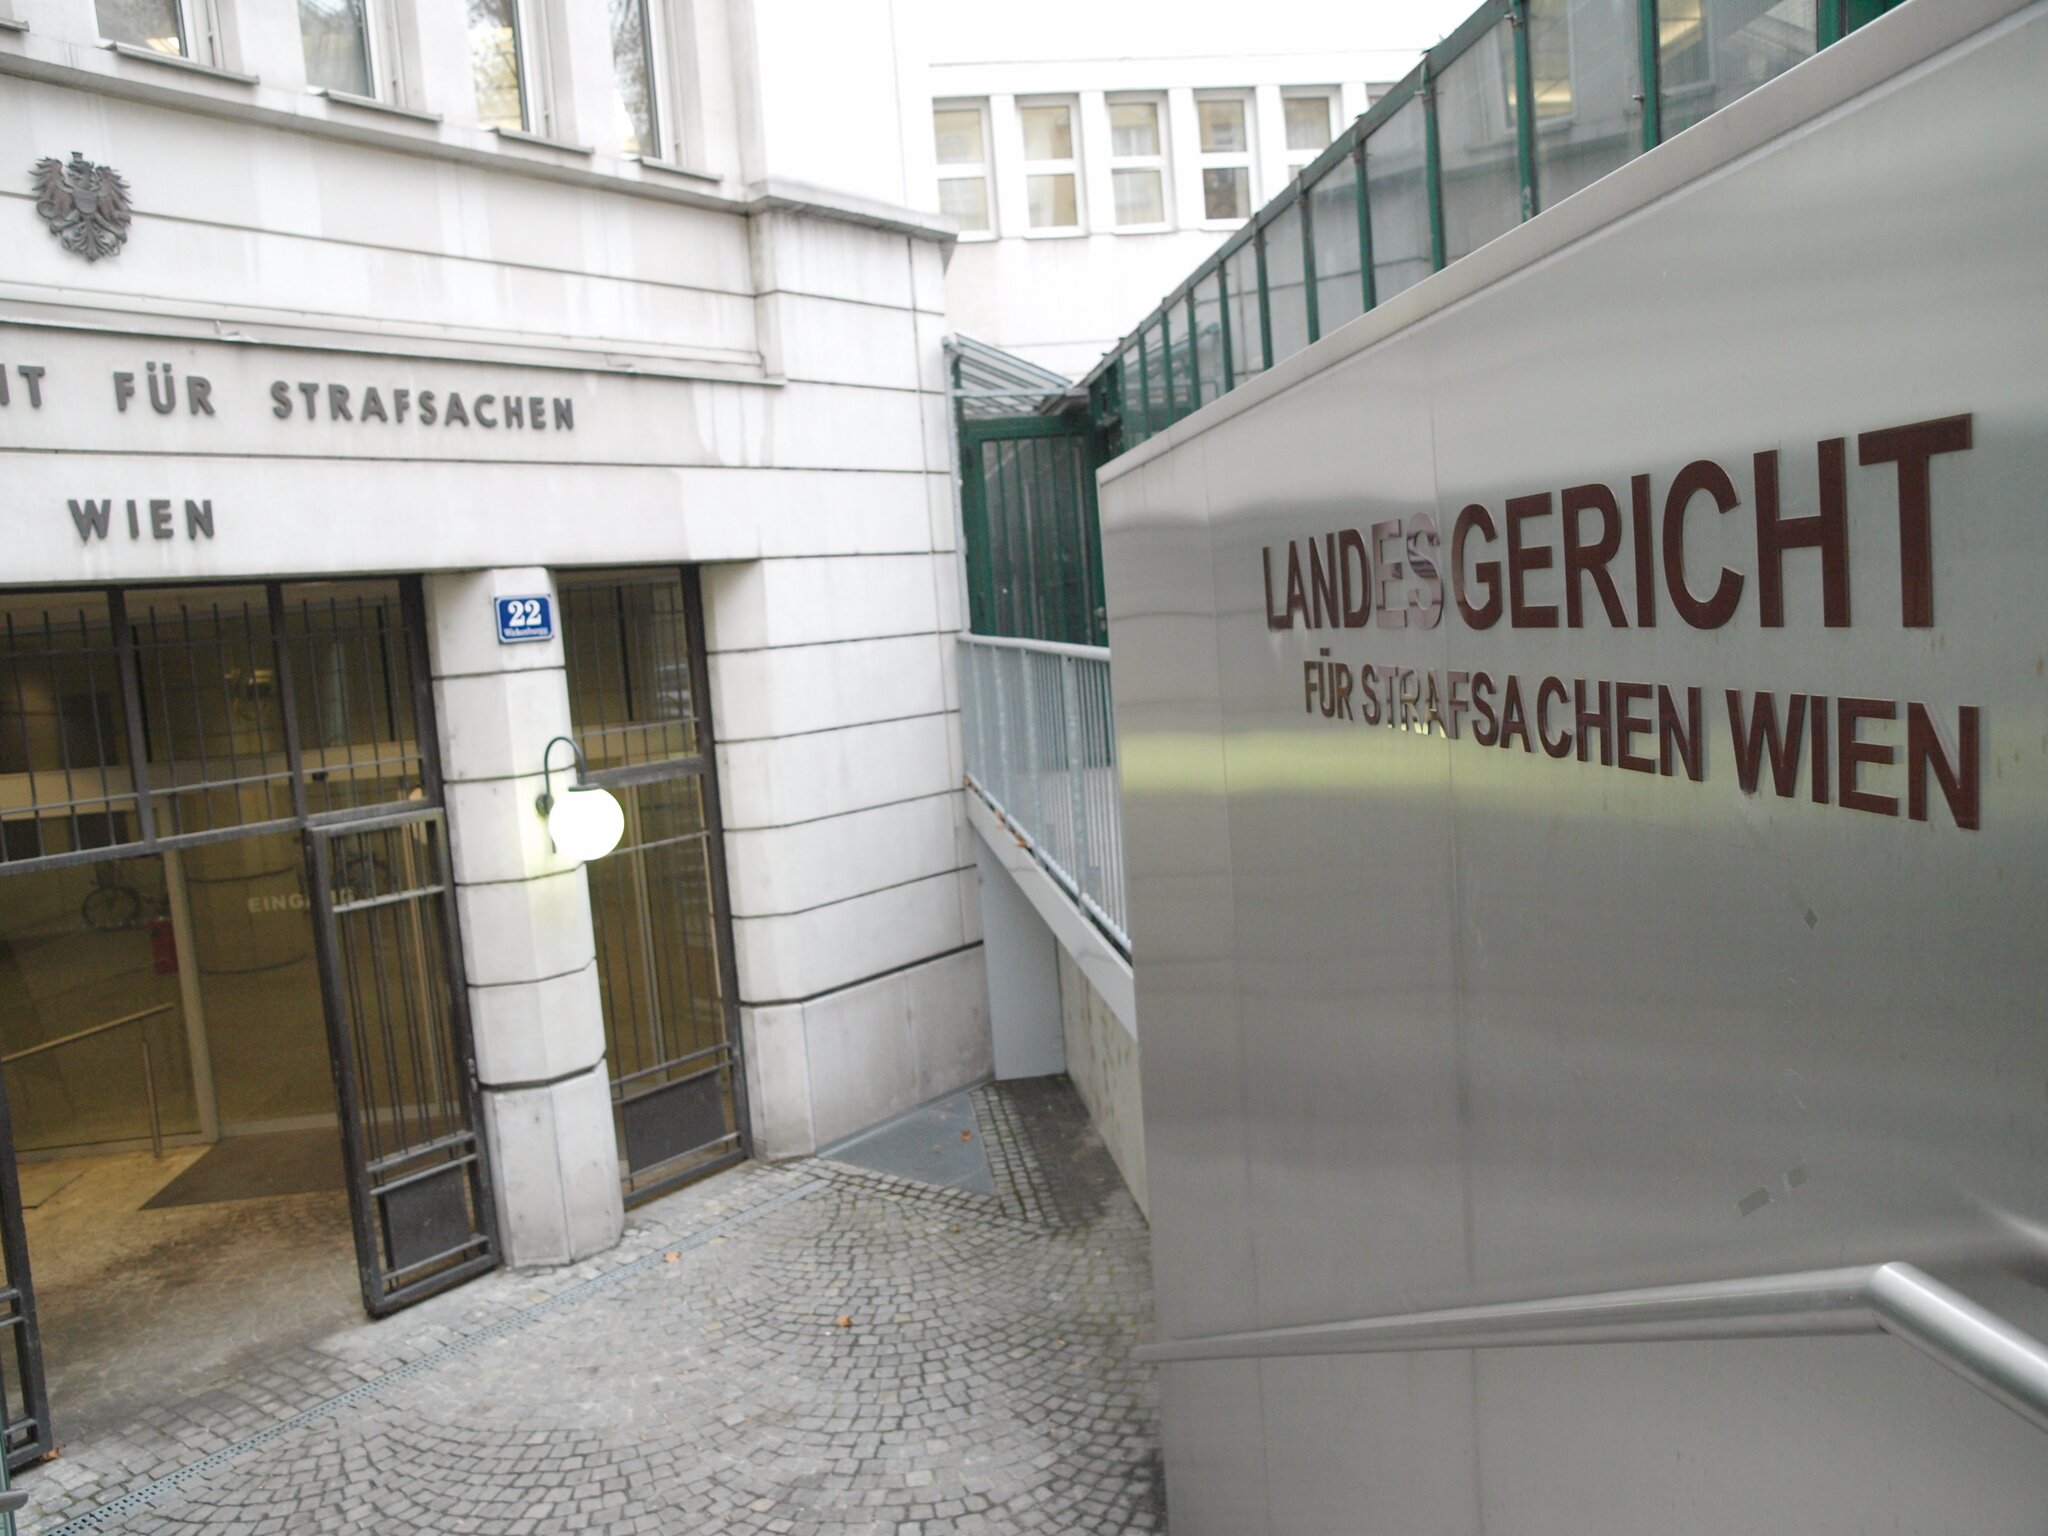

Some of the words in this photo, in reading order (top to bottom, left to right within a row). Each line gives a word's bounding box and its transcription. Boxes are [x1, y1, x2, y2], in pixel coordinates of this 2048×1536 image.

[113, 361, 216, 416] FÜR
[270, 380, 575, 430] STRAFSACHEN
[68, 499, 215, 542] WIEN
[1262, 412, 1973, 631] LANDESGERICHT
[507, 599, 542, 627] 22
[1303, 647, 1354, 722] FÜR
[1361, 663, 1704, 783] STRAFSACHEN
[1726, 688, 1981, 832] WIEN
